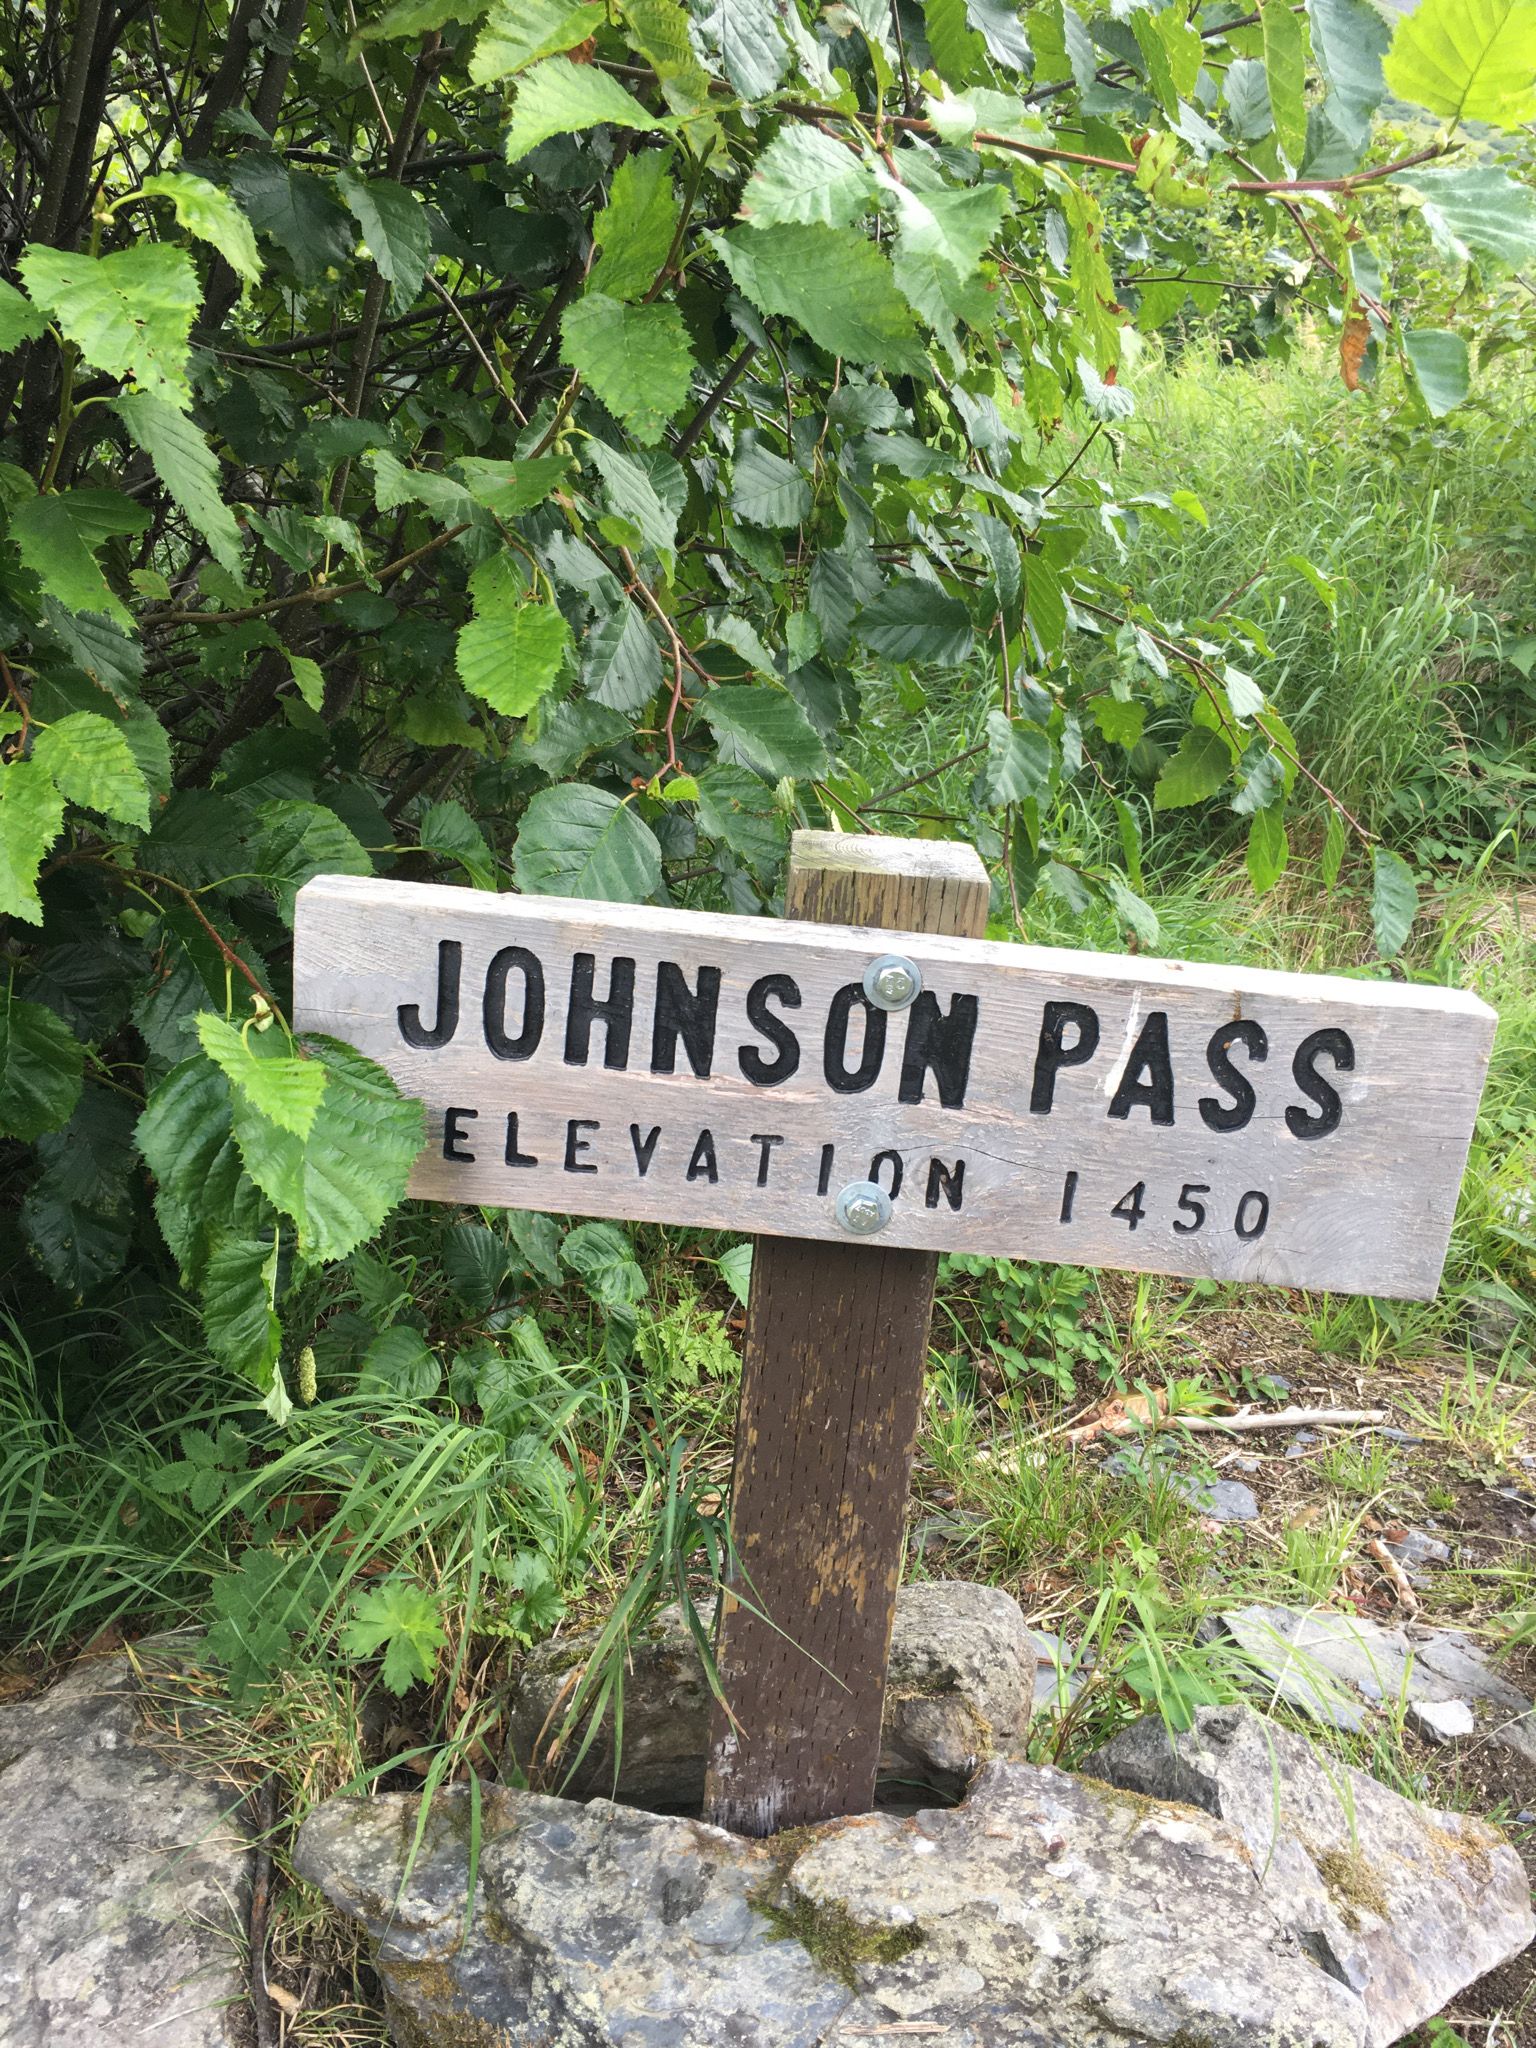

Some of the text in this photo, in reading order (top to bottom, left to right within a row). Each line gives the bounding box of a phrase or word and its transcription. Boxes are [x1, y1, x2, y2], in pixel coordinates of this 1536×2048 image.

[398, 939, 1355, 1140] JOHNSON PASS
[443, 1107, 1270, 1241] ELEVATION 1450
